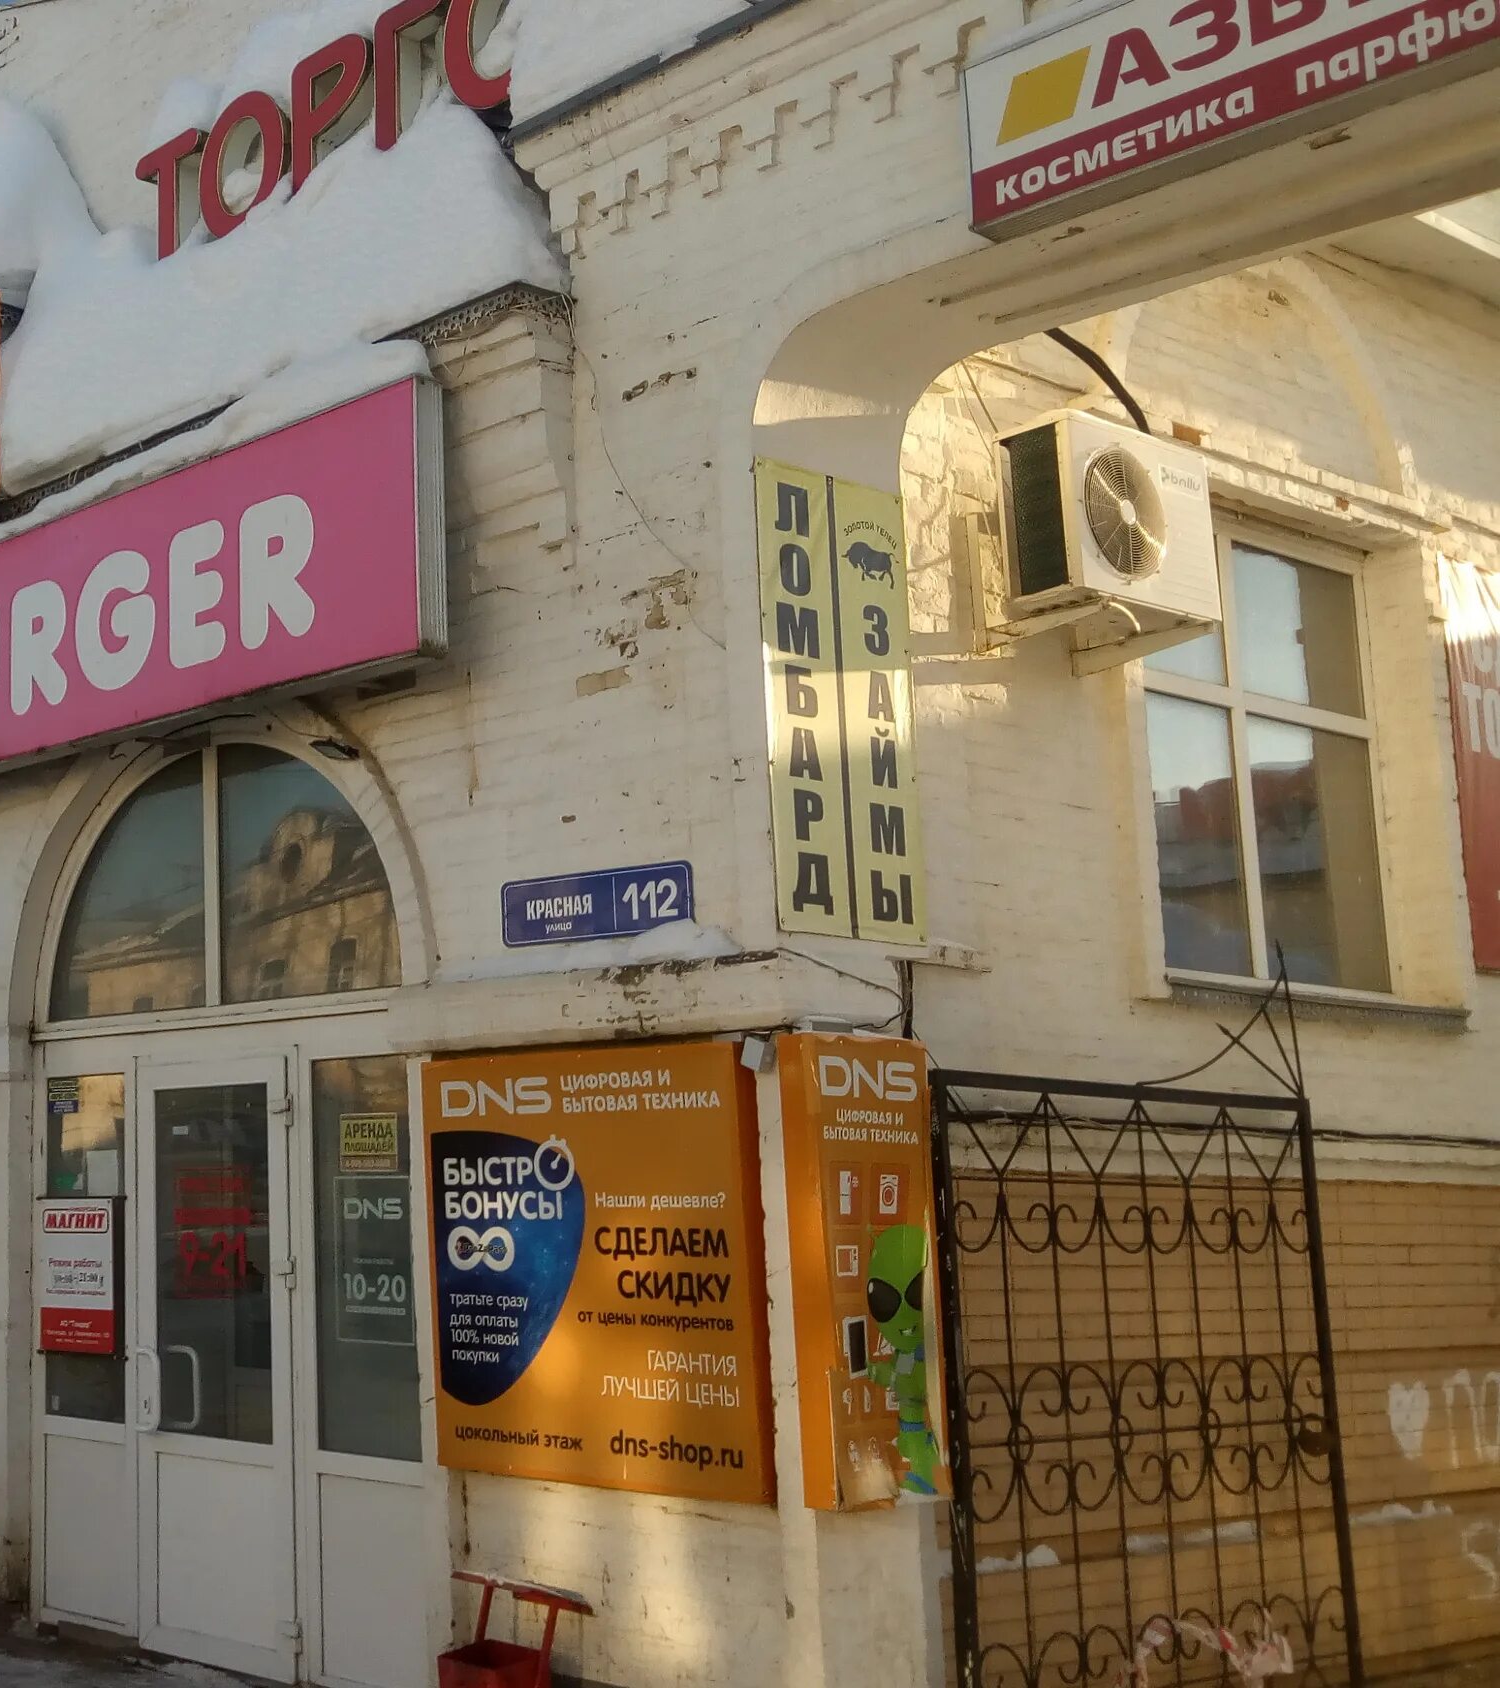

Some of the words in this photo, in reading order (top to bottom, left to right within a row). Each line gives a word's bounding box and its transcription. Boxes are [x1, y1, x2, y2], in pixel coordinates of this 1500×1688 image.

[996, 86, 1255, 206] косметика
[844, 521, 875, 536] ЗОЛОТОЙ
[876, 525, 897, 550] ТЕЛЕЦ
[774, 481, 835, 916] ЛОМБАРД
[862, 603, 915, 925] ЗАЙМЫ
[526, 893, 593, 920] КРАСНАЯ
[621, 878, 679, 921] 112
[545, 921, 573, 934] улица
[561, 1070, 653, 1093] ЦИФРОВАЯ
[658, 1069, 671, 1087] И
[818, 1055, 918, 1102] DNS
[440, 1076, 552, 1118] DNS
[562, 1093, 638, 1114] БЫТОВАЯ
[642, 1090, 721, 1111] ТЕХНИКА
[836, 1108, 892, 1125] ЦИФРОВАЯ
[895, 1112, 904, 1126] И
[344, 1122, 394, 1141] АРЕНДА
[823, 1125, 868, 1142] БЫТОВАЯ
[870, 1128, 919, 1145] ТЕХНИКА
[343, 1198, 404, 1220] DNS
[444, 1190, 563, 1220] БОНУСЫ
[594, 1192, 646, 1209] Нашли
[650, 1192, 726, 1211] дешевле?
[45, 1212, 106, 1230] МАГНИТ
[179, 1231, 247, 1277] 9-21
[594, 1226, 730, 1262] СДЕЛАЕМ
[343, 1272, 407, 1303] 10-20
[617, 1269, 731, 1308] СКИДКУ
[450, 1293, 494, 1308] тратьте
[496, 1295, 529, 1311] сразу
[450, 1314, 472, 1327] для
[475, 1315, 519, 1328] оплаты
[577, 1311, 593, 1323] от
[598, 1312, 636, 1327] цены
[640, 1314, 734, 1333] конкурентов
[451, 1329, 480, 1344] 100%
[483, 1332, 519, 1346] новой
[452, 1349, 500, 1365] покупки
[647, 1349, 738, 1377] ГАРАНТИЯ
[601, 1375, 681, 1403] ЛУЧШЕЙ
[686, 1384, 740, 1408] ЦЕНЫ
[455, 1424, 540, 1447] цокольный
[543, 1432, 583, 1451] этаж
[610, 1429, 744, 1471] dns-shop.ru
